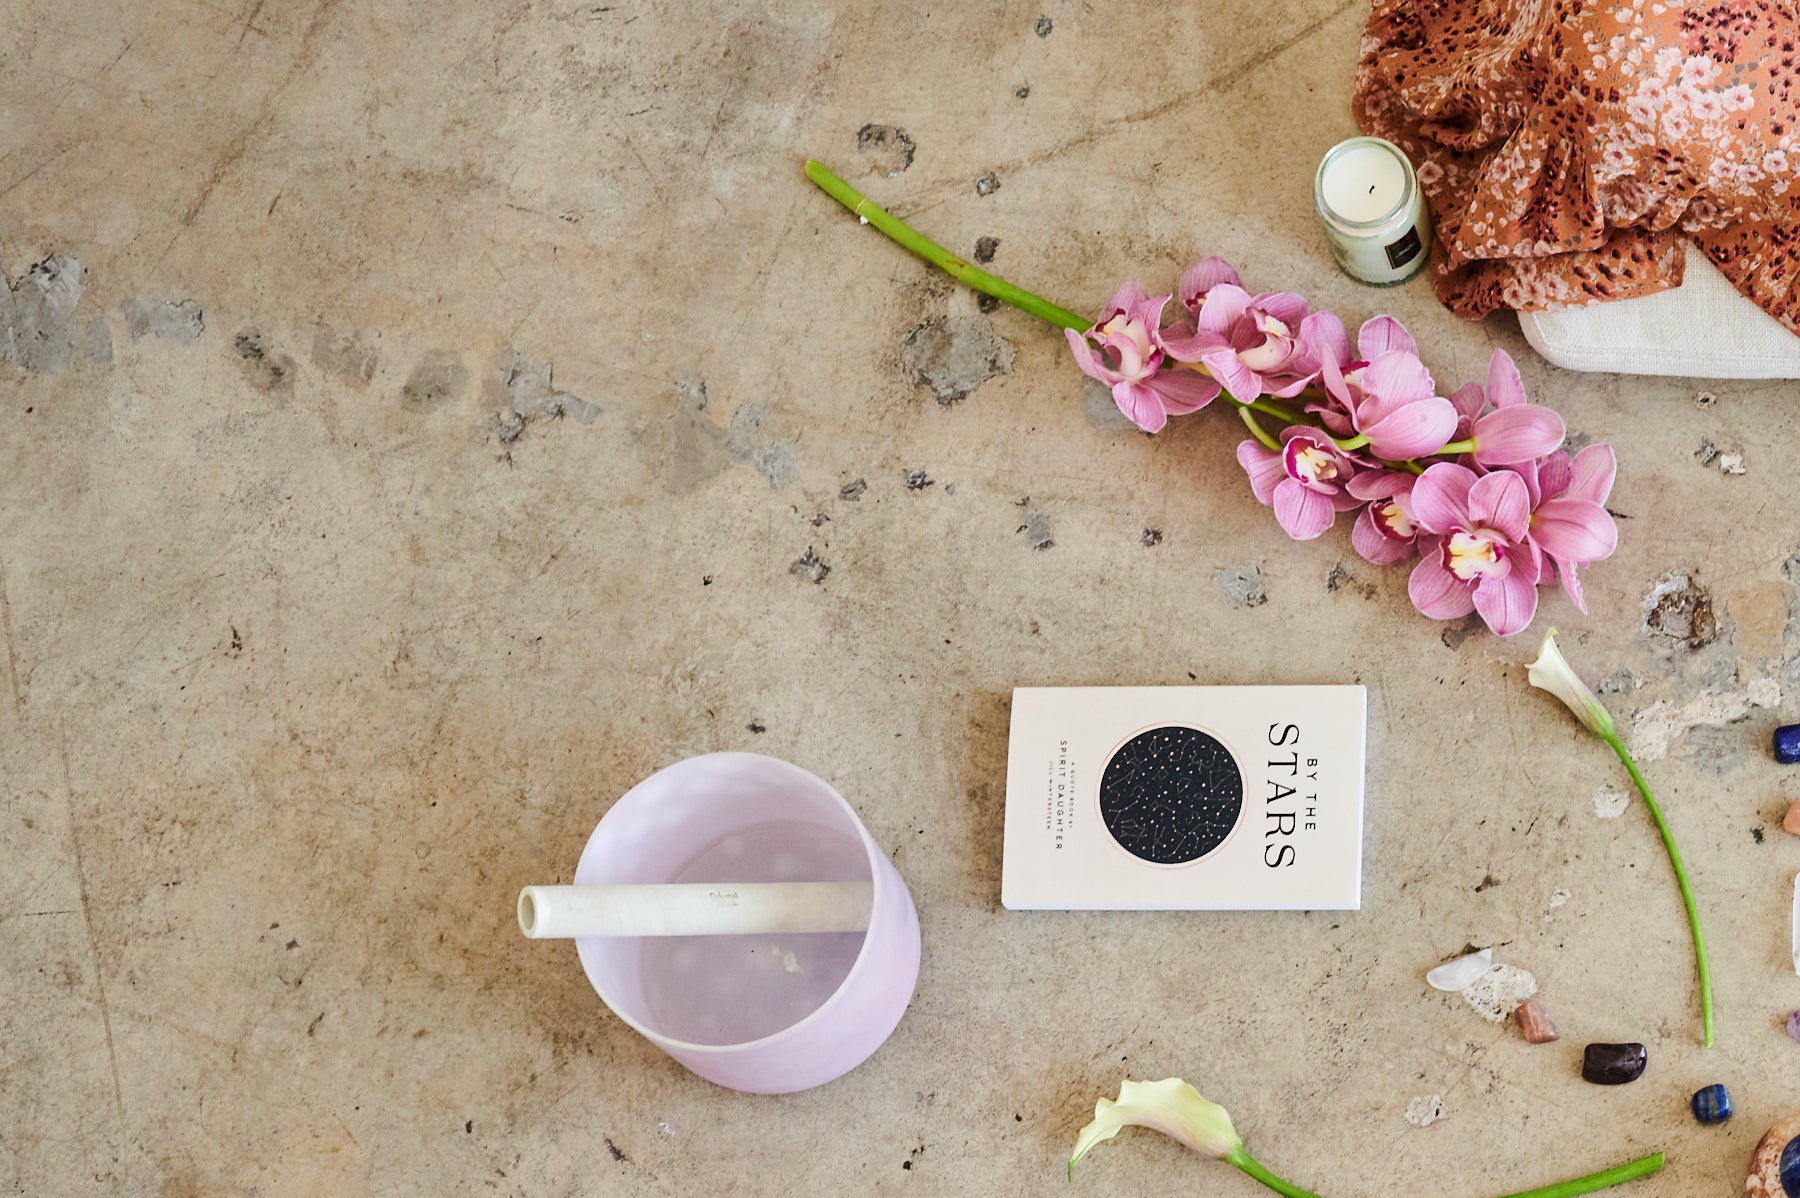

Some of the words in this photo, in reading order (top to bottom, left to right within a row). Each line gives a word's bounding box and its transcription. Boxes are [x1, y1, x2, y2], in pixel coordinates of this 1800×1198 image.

[1059, 740, 1067, 777] SPIRIT
[1306, 758, 1318, 781] BY
[1264, 723, 1300, 868] STARS
[1305, 793, 1317, 830] THE
[1056, 784, 1065, 849] DAUGHTER
